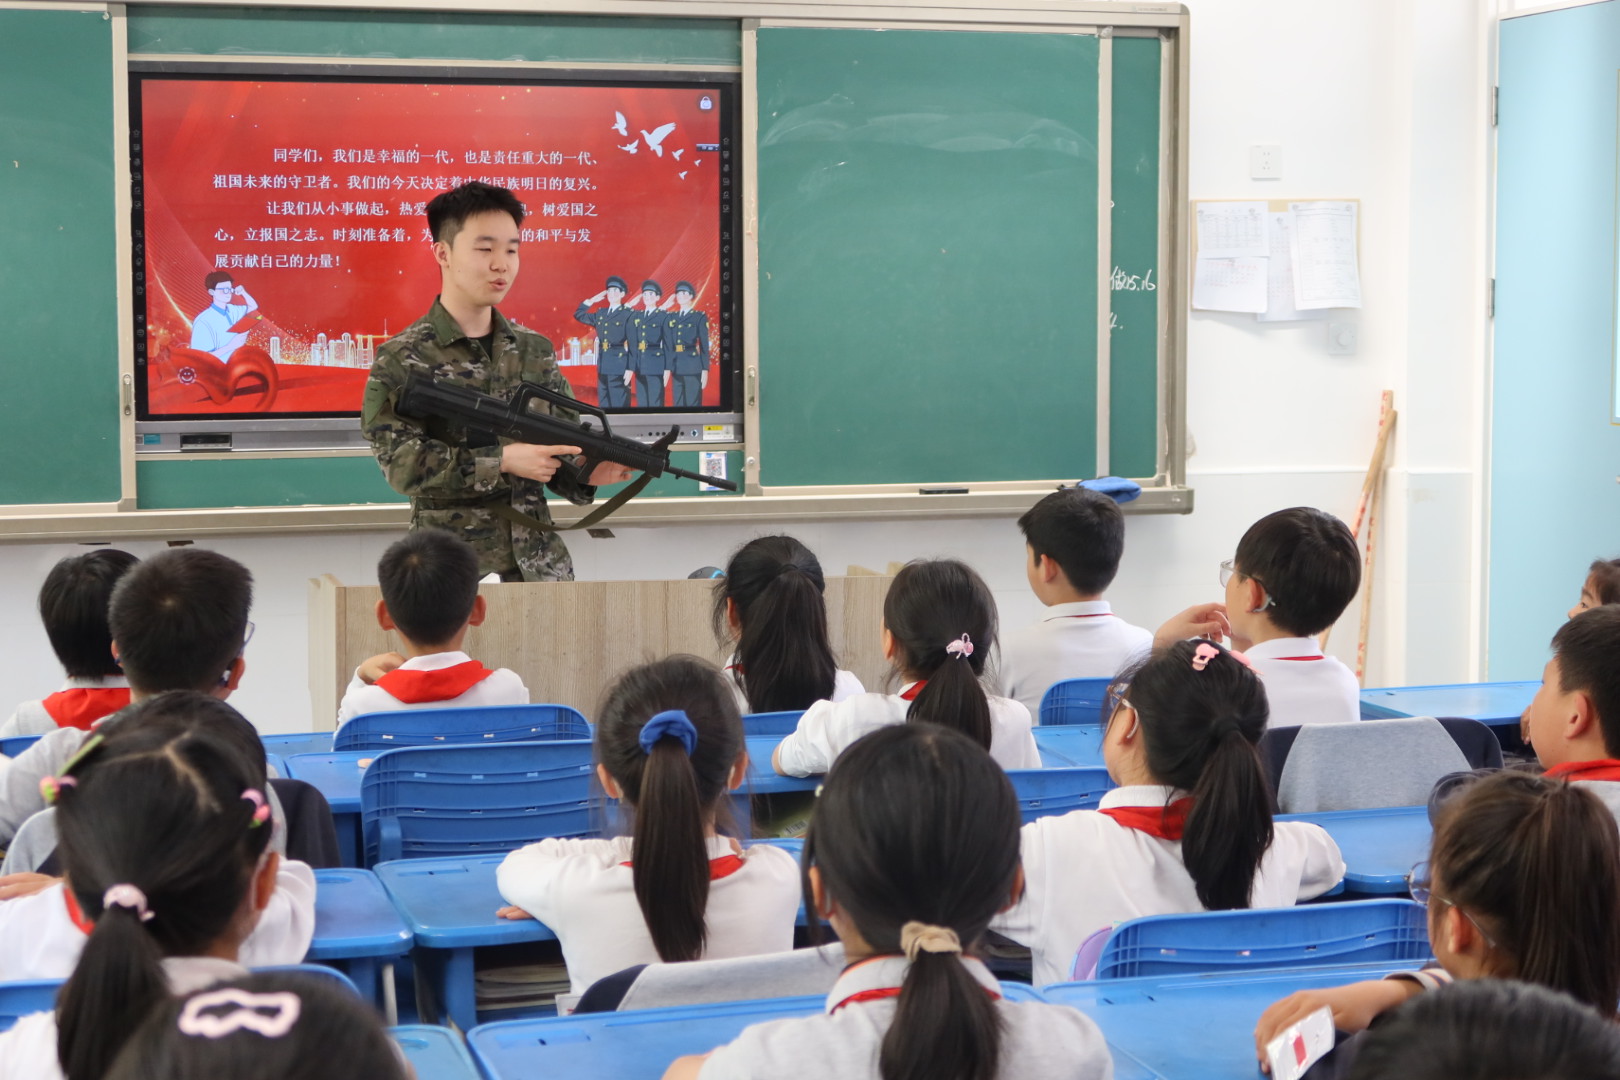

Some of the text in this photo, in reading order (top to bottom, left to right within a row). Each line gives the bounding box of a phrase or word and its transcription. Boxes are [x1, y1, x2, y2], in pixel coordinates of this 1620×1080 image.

[214, 253, 341, 269] 展贡献自己的力量！
